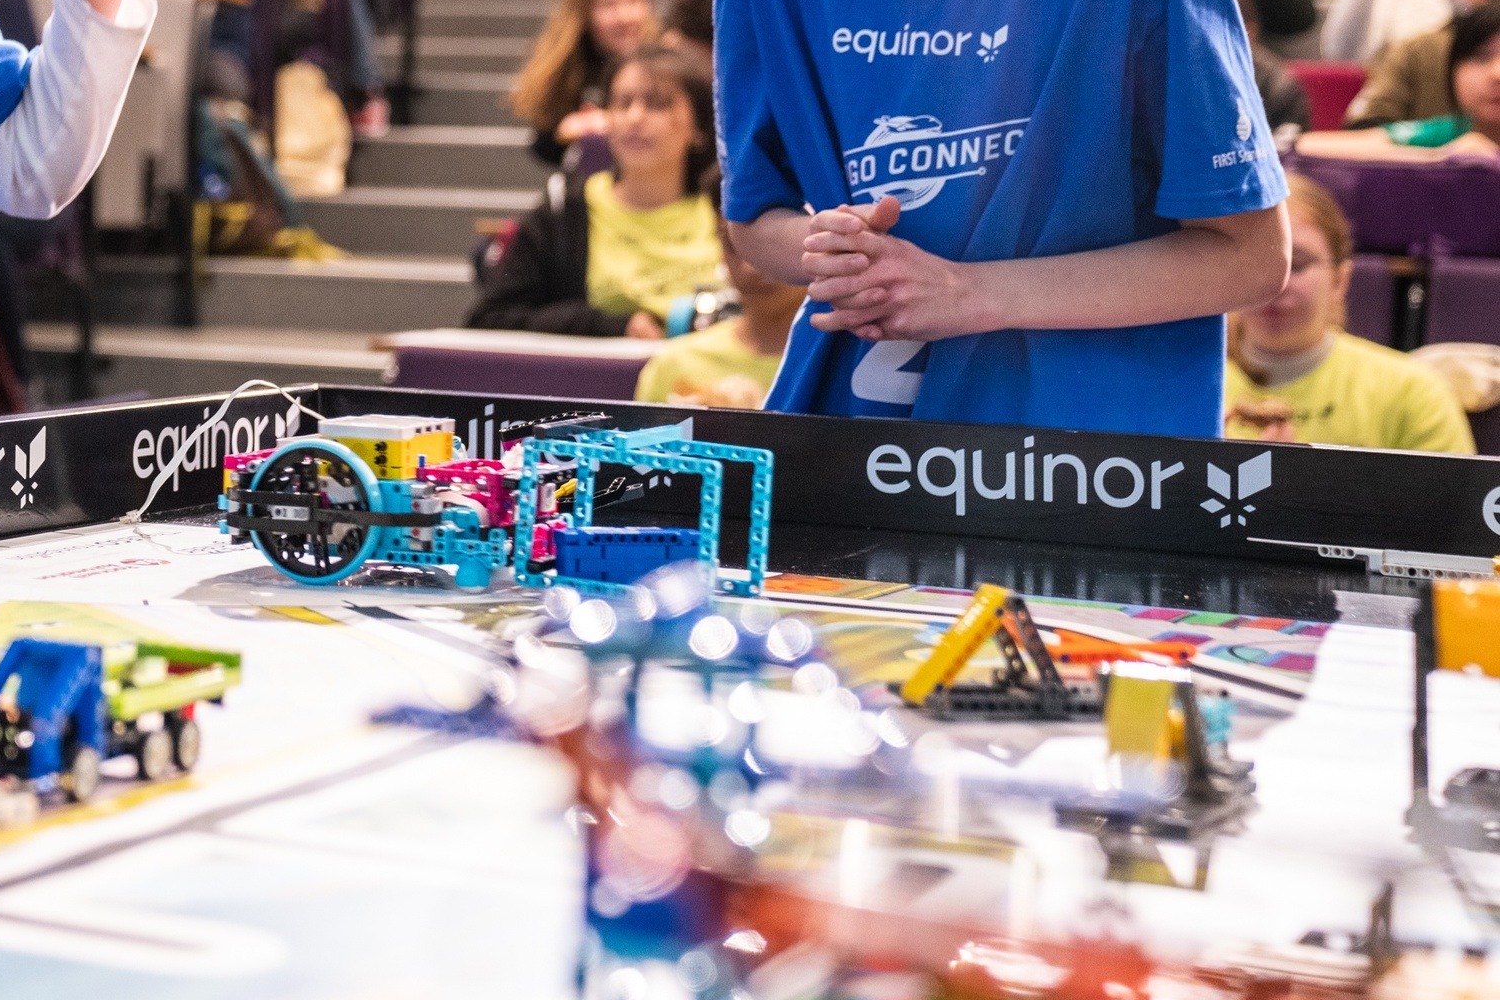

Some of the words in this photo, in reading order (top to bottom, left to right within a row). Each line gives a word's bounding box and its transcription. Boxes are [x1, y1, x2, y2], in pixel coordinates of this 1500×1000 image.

[831, 22, 973, 64] equinor
[888, 129, 1025, 176] CONNEC
[132, 406, 270, 493] equinor
[865, 434, 1186, 517] equinor
